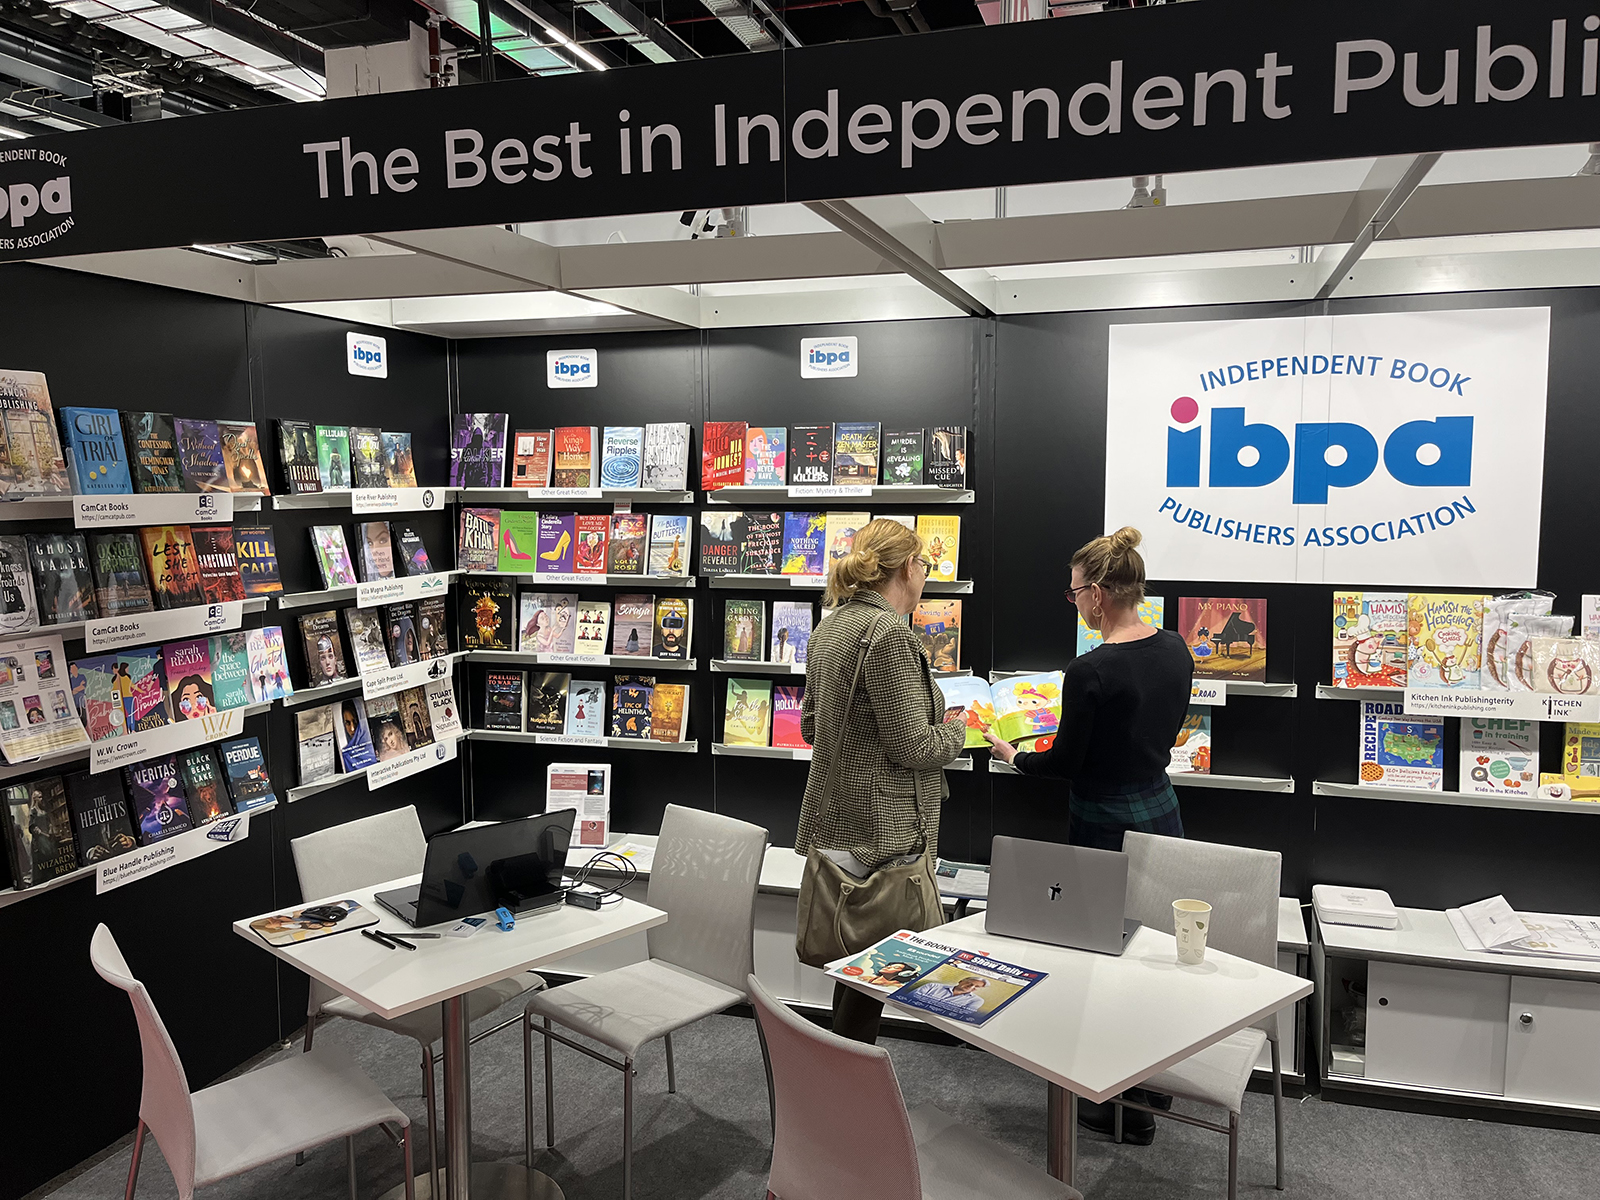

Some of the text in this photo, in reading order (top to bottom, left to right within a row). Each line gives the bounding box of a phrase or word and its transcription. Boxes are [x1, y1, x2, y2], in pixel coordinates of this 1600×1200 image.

[303, 15, 1600, 198] The Best in Independent Publi
[39, 150, 67, 167] BOOK
[17, 216, 75, 249] ASSOCIATION
[353, 345, 382, 363] ibpa
[809, 349, 850, 365] ibpa
[555, 361, 590, 376] ibpa
[1200, 354, 1472, 396] INDEPENDENT BOOK
[74, 414, 119, 437] GIRL
[138, 440, 172, 449] CONFESSION
[563, 435, 584, 445] King's
[851, 440, 877, 448] MASTER
[77, 441, 123, 462] TRIAL
[451, 448, 504, 459] STALKER
[565, 444, 582, 454] Way
[1166, 396, 1475, 505] ibpa
[140, 457, 174, 466] HEMINGWAY
[563, 452, 584, 460] Home
[887, 455, 920, 463] REVEALING
[758, 472, 773, 480] HAVE
[805, 466, 825, 475] KILL
[793, 473, 829, 482] KILLERS
[377, 493, 397, 501] Publishing
[81, 502, 129, 512] CamCat Books
[195, 508, 218, 516] CamCat
[465, 512, 488, 534] BATU
[621, 519, 643, 528] Eye
[665, 518, 680, 528] BLUE
[1158, 495, 1477, 547] PUBLISHERS ASSOCIATION
[653, 525, 686, 539] BUTTERFLY
[464, 528, 492, 550] KHAN
[36, 542, 82, 555] GHOST
[97, 542, 138, 559] OXYGEN
[153, 542, 191, 557] LEST
[236, 541, 275, 558] KILL
[702, 545, 738, 556] DANGER
[746, 548, 781, 557] SUBSTANCE
[100, 557, 140, 573] FARMER
[164, 557, 188, 570] SHE
[198, 552, 237, 568] SANCTUARY
[702, 556, 738, 565] REVEALED
[240, 562, 273, 575] CALL
[160, 571, 198, 584] FORGET
[384, 583, 403, 591] Publishing
[3, 590, 15, 603] Us
[1198, 602, 1248, 612] MY PIANO
[1427, 601, 1473, 617] HAMISH THE
[727, 614, 759, 622] GARDEN
[1424, 612, 1475, 632] HEDGEHOG
[92, 622, 140, 636] CamCat Books
[175, 644, 199, 657] sarah
[249, 637, 281, 652] READY
[170, 652, 205, 667] READY
[222, 653, 236, 664] the
[219, 661, 241, 671] space
[214, 668, 248, 681] between
[386, 676, 398, 684] Press
[225, 688, 243, 698] sarah
[430, 689, 452, 700] STUART
[1199, 690, 1217, 698] ROAD
[1411, 693, 1515, 706] Kitchen Ink Publishingterity
[222, 695, 247, 707] READY
[433, 698, 453, 709] BLACK
[1365, 702, 1404, 715] ROAD
[141, 712, 161, 722] sarah
[138, 719, 165, 731] READY
[1471, 718, 1531, 731] CHEF
[1568, 727, 1591, 735] Made
[205, 731, 228, 741] CROWN
[1495, 732, 1529, 743] training
[97, 741, 138, 757] W.W. Crown
[226, 746, 260, 763] PERDUE
[186, 754, 211, 767] BLACK
[134, 763, 176, 784] VERITAS
[191, 764, 211, 774] BEAR
[371, 765, 391, 778] Interactive
[391, 757, 414, 771] Publications
[193, 773, 213, 783] LAKE
[93, 795, 107, 806] THE
[80, 801, 126, 829] HEIGHTS
[57, 844, 73, 855] THE
[103, 844, 175, 877] Blue Handle Publishing
[55, 861, 77, 875] BREW
[909, 935, 957, 954] THE BOOKSE
[971, 956, 1024, 976] Show Daily
